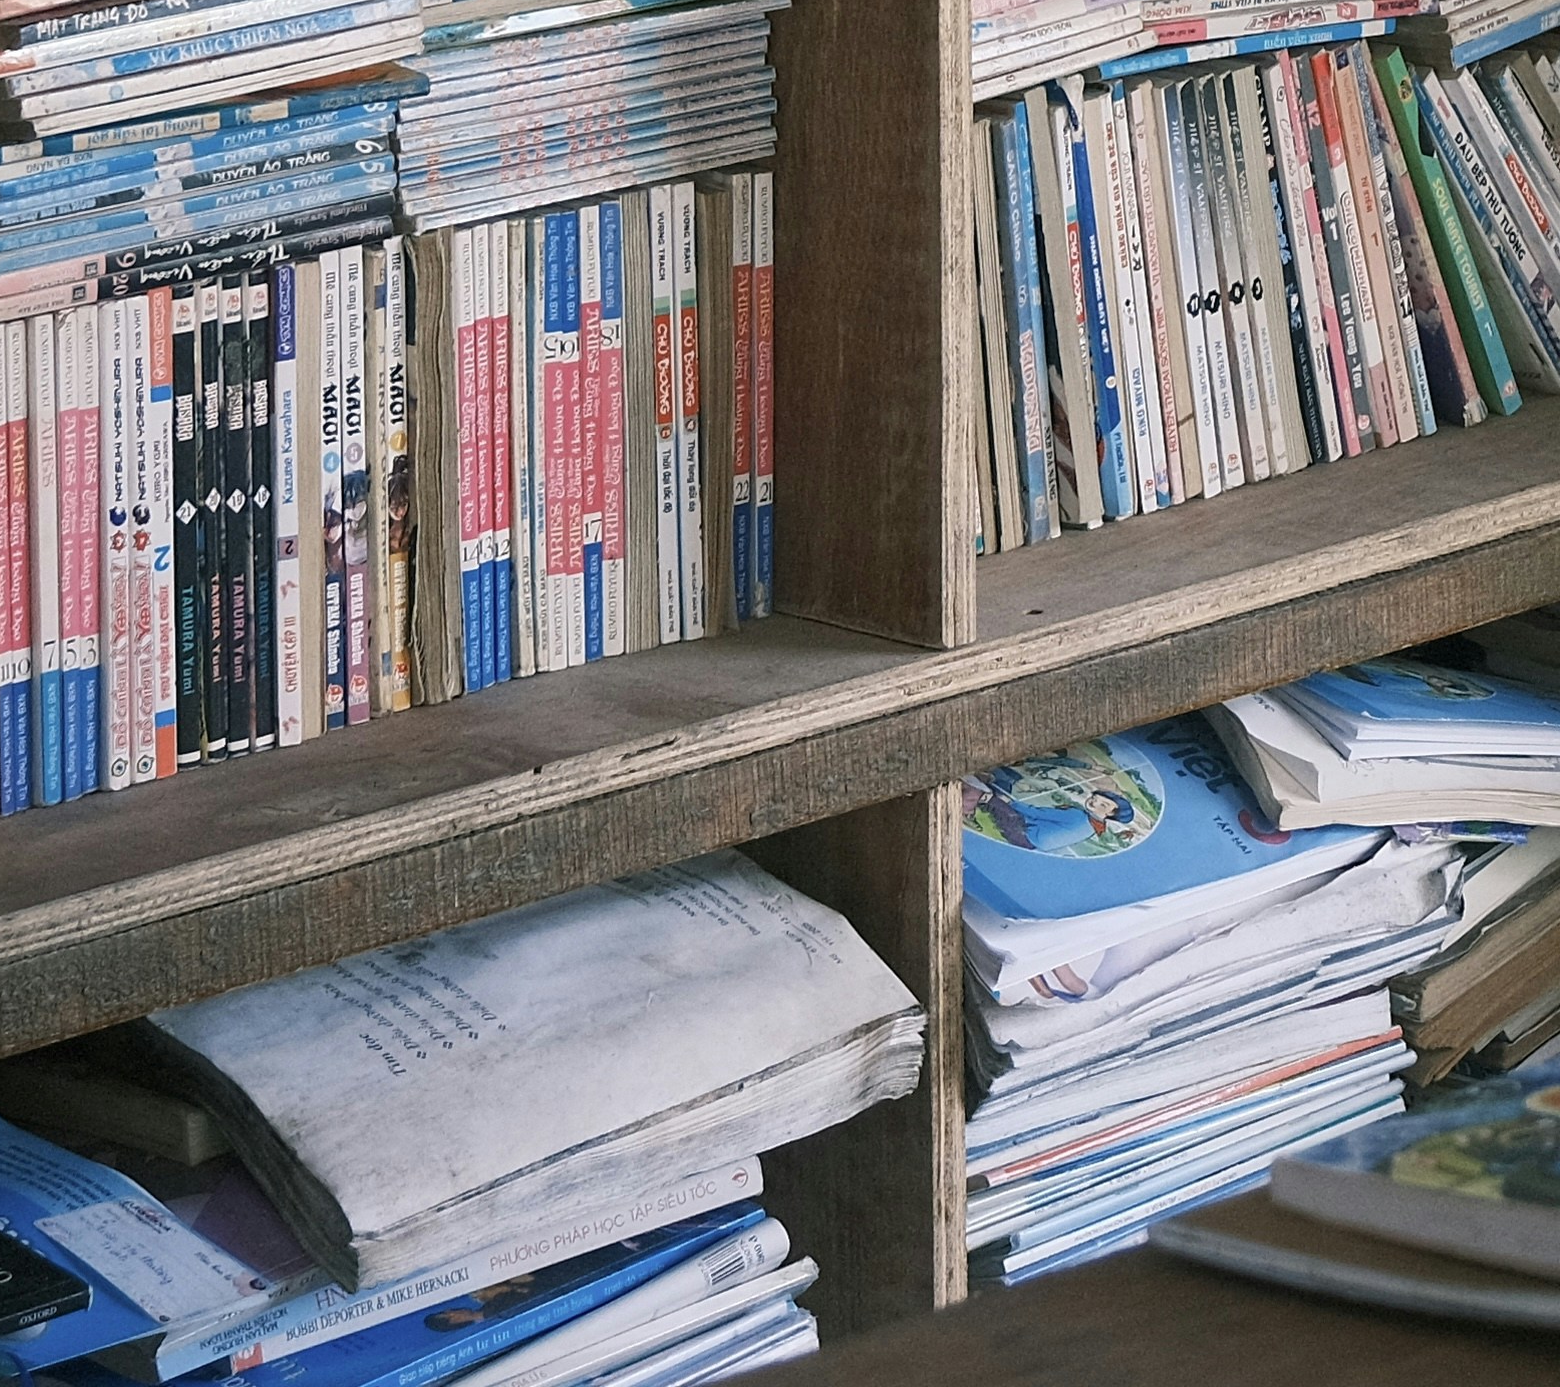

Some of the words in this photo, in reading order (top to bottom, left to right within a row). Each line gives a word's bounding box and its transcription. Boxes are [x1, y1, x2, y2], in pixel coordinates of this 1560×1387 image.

[490, 1239, 551, 1272] PHƯƠNG
[553, 1224, 591, 1251] PHÁP
[592, 1213, 625, 1240] HỌC
[629, 1202, 654, 1224] TẬP
[656, 1189, 687, 1213] SIÊU
[688, 1178, 718, 1204] TỐC
[285, 1317, 320, 1342] BOBBI
[320, 1300, 374, 1332] DEPORTER
[376, 1296, 386, 1309] &
[387, 1285, 415, 1309] MIKE
[414, 1267, 470, 1302] HERNACKI
